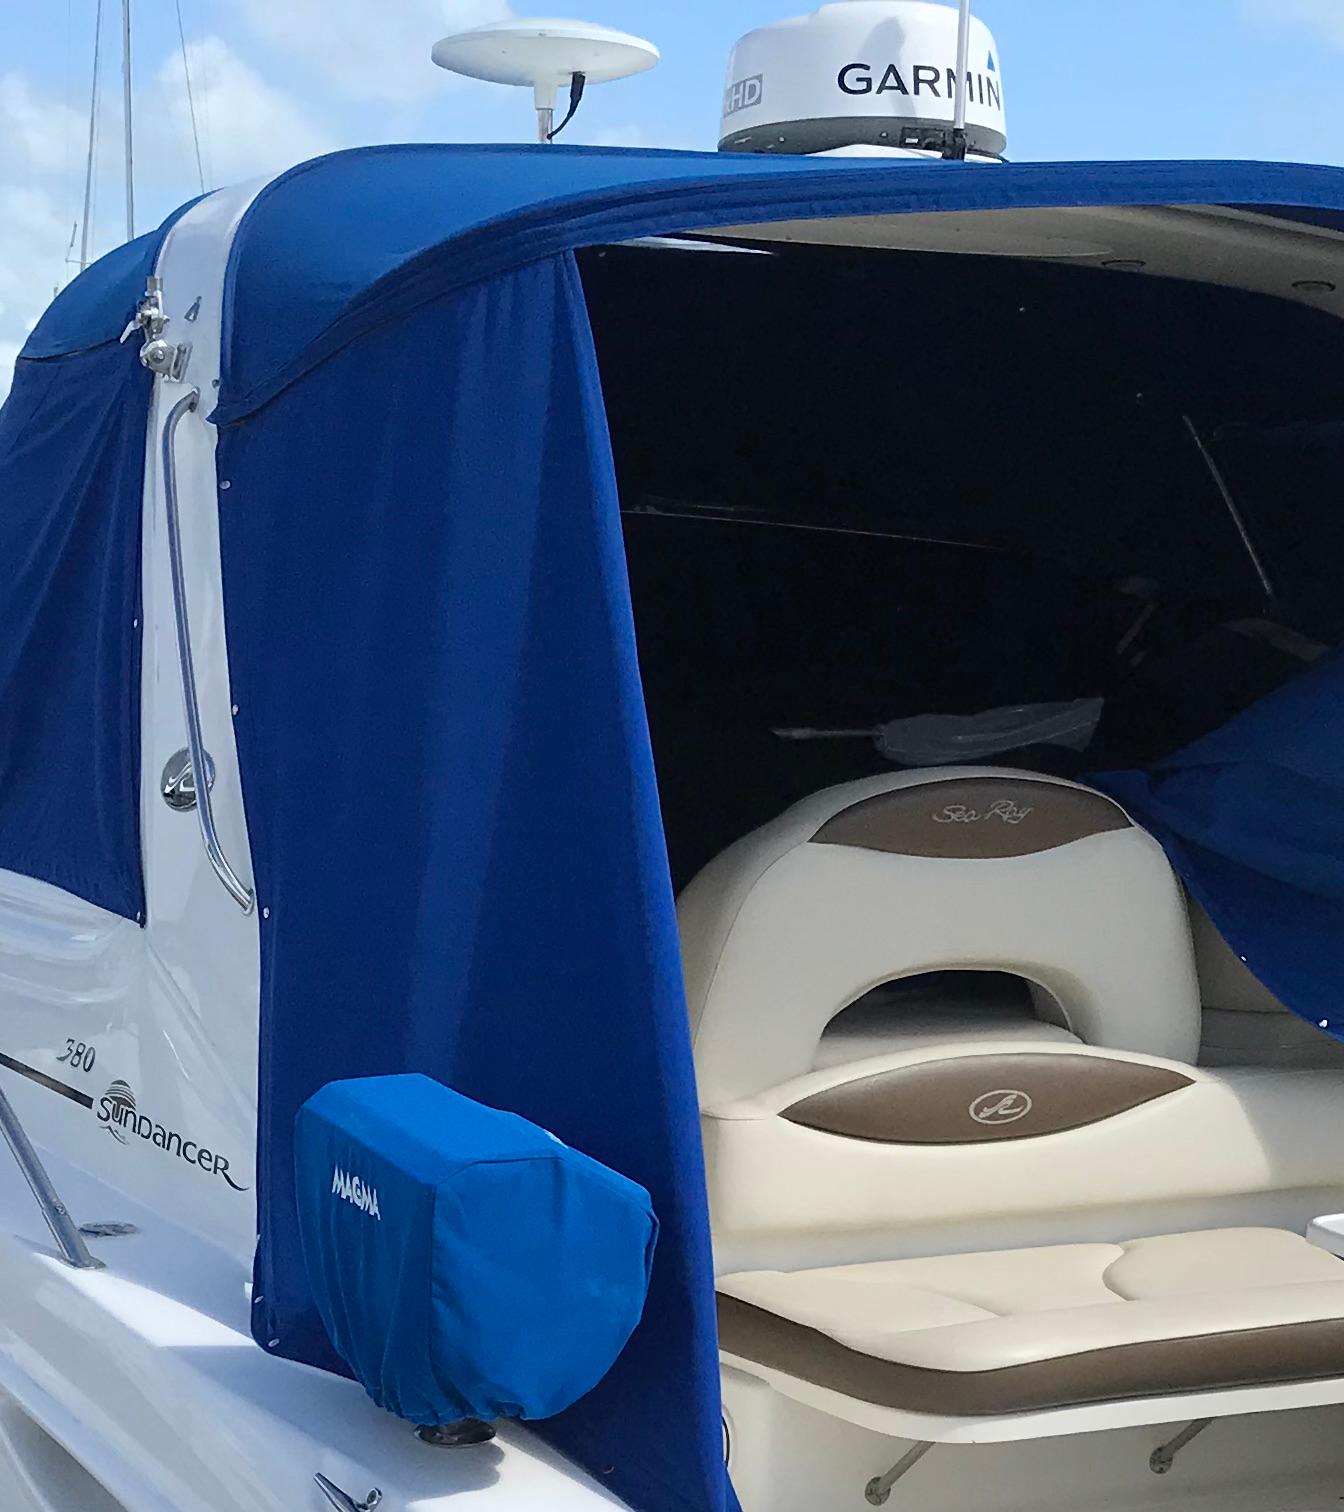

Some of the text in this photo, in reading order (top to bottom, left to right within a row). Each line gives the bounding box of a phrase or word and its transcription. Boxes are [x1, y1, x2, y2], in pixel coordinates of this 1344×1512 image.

[837, 62, 1001, 111] GARMIN
[56, 1037, 96, 1073] 380
[331, 1163, 381, 1221] MAGMA
